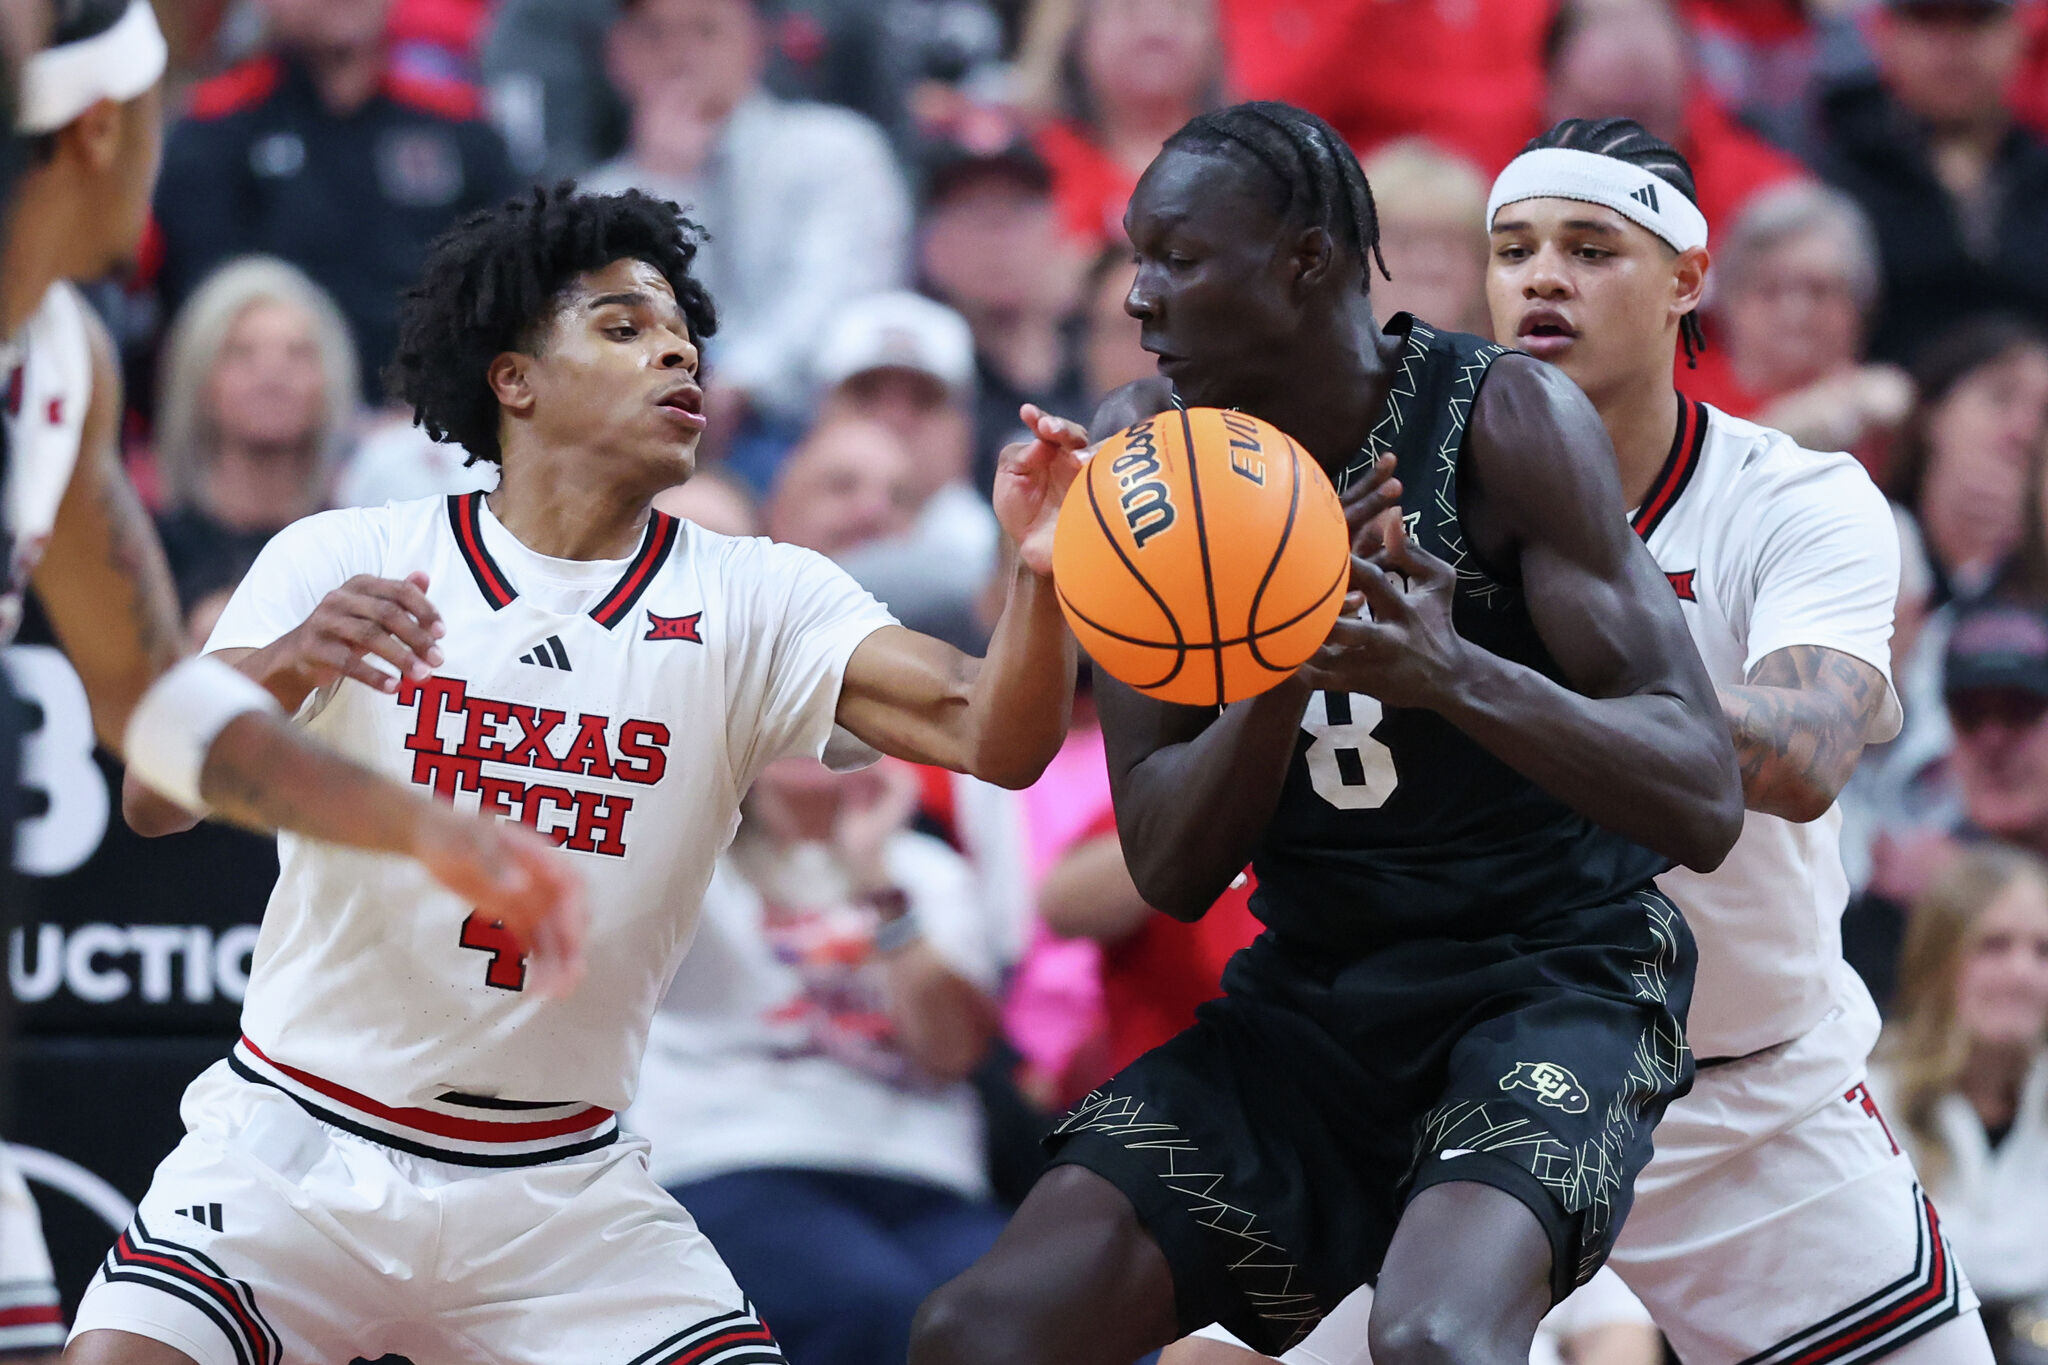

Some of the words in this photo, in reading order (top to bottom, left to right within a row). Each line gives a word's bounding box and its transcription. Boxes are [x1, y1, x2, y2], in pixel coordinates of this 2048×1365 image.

[397, 674, 671, 785] TEXAS
[1300, 689, 1399, 810] 8
[411, 750, 634, 857] TECH
